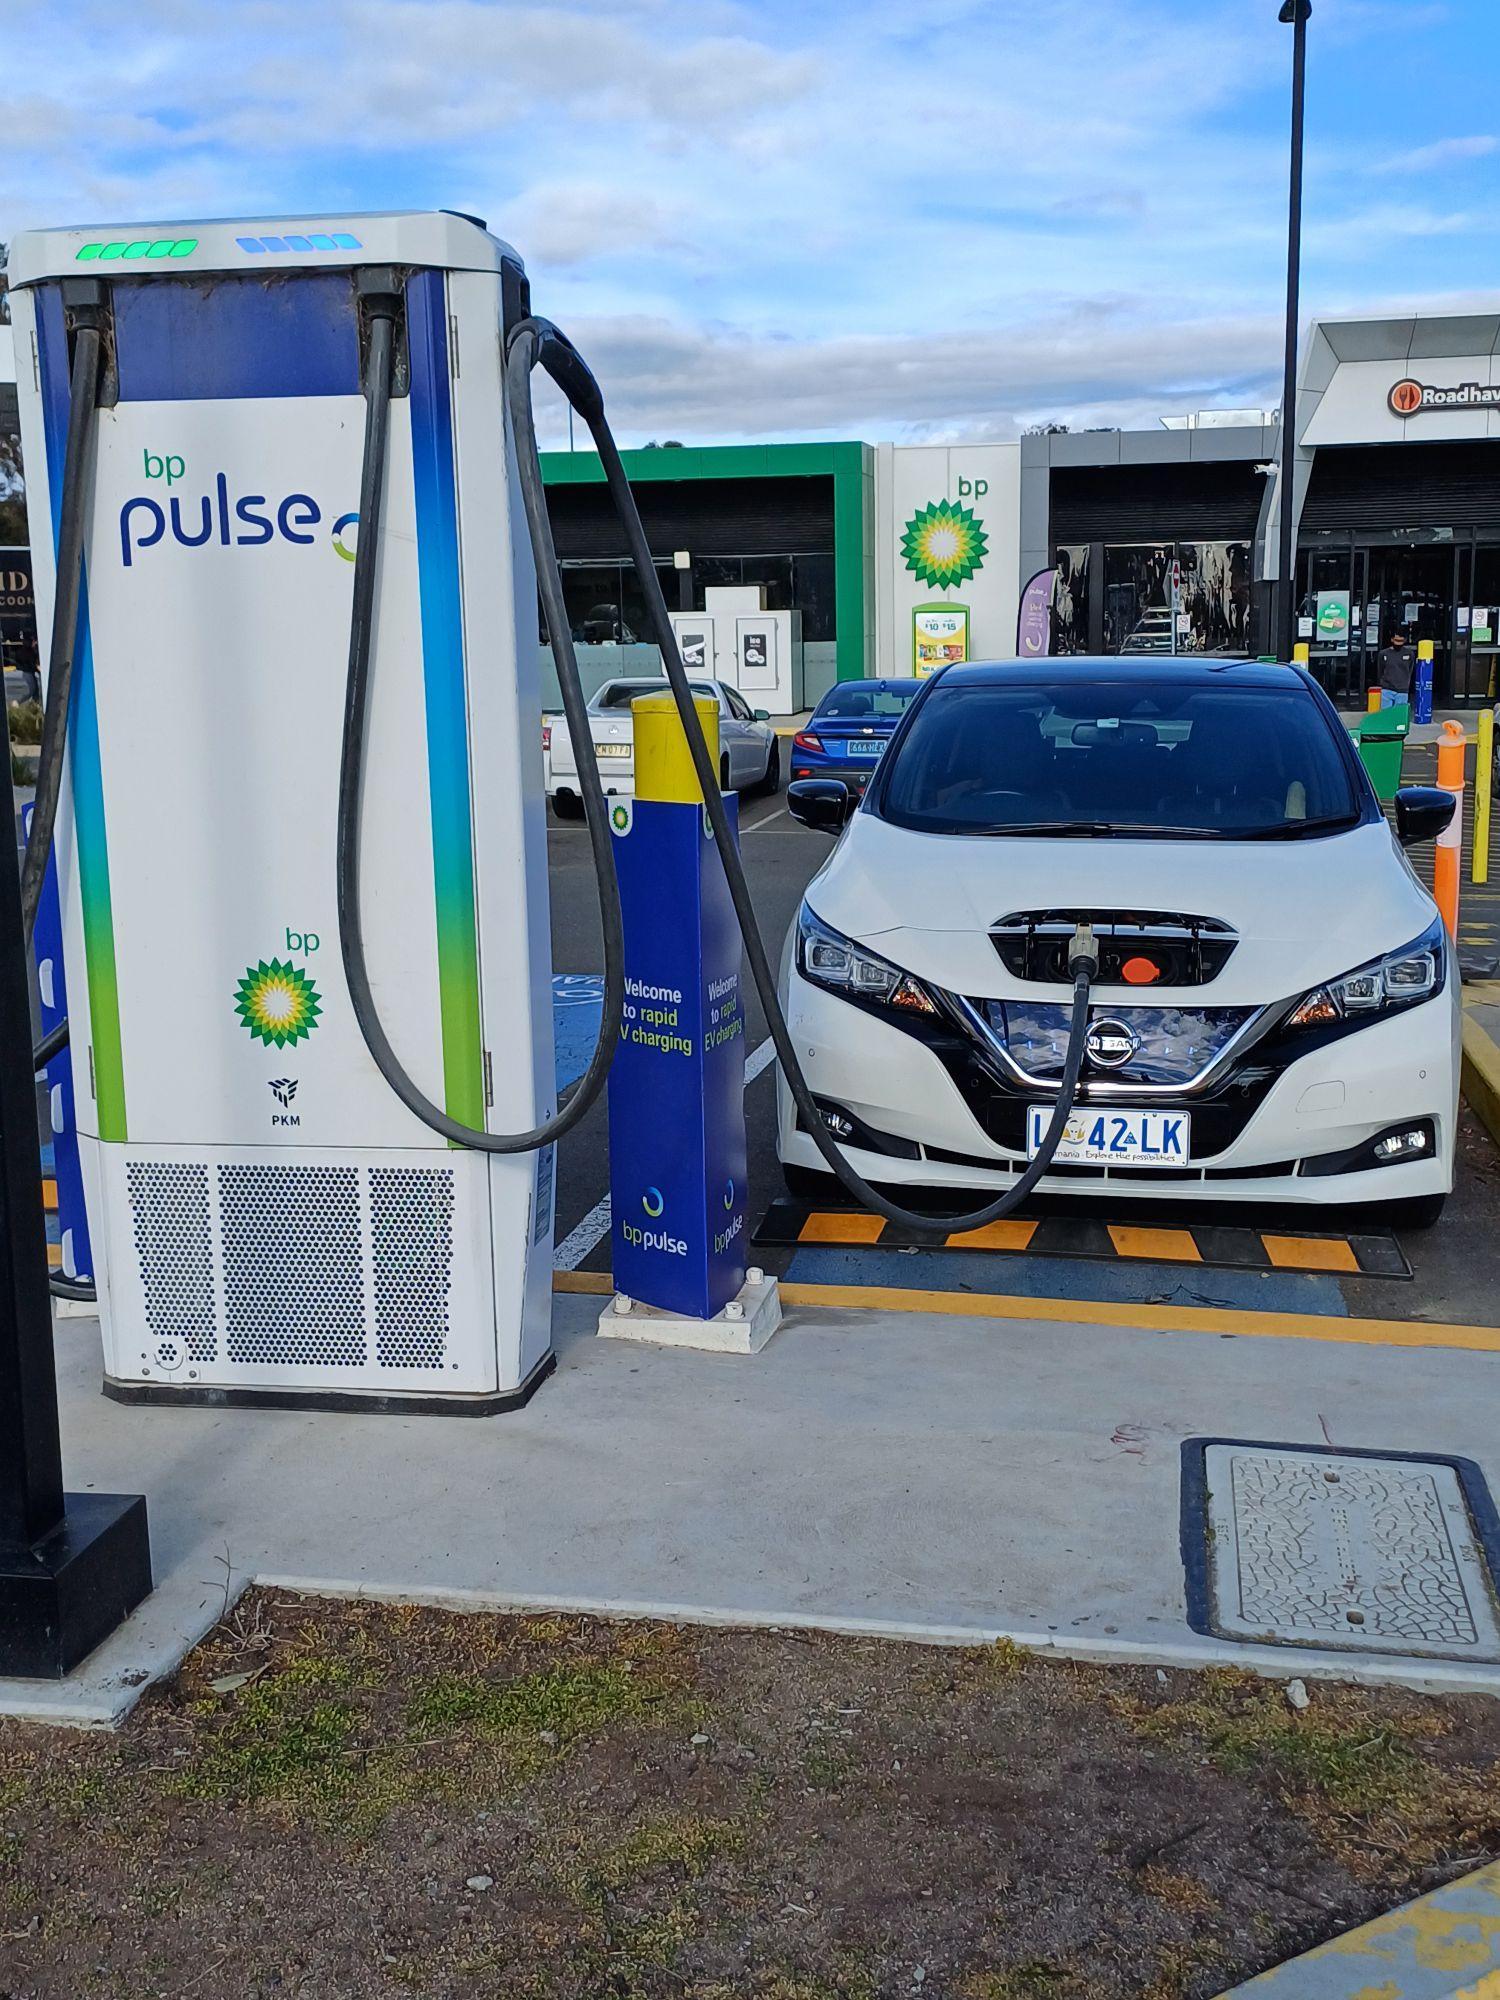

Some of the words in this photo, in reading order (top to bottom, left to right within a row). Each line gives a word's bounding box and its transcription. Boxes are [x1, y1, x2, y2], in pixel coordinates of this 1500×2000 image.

[144, 449, 185, 486] bp
[958, 475, 989, 500] bp
[120, 472, 321, 567] pulse
[286, 927, 320, 957] bp
[708, 974, 738, 1002] Welcome
[623, 1002, 636, 1019] to
[640, 1007, 678, 1027] rapid
[710, 1007, 720, 1024] to
[720, 993, 737, 1019] rapid
[631, 1027, 692, 1057] charging
[705, 1030, 716, 1052] EV
[717, 1017, 742, 1045] charging
[272, 1115, 301, 1126] PKM
